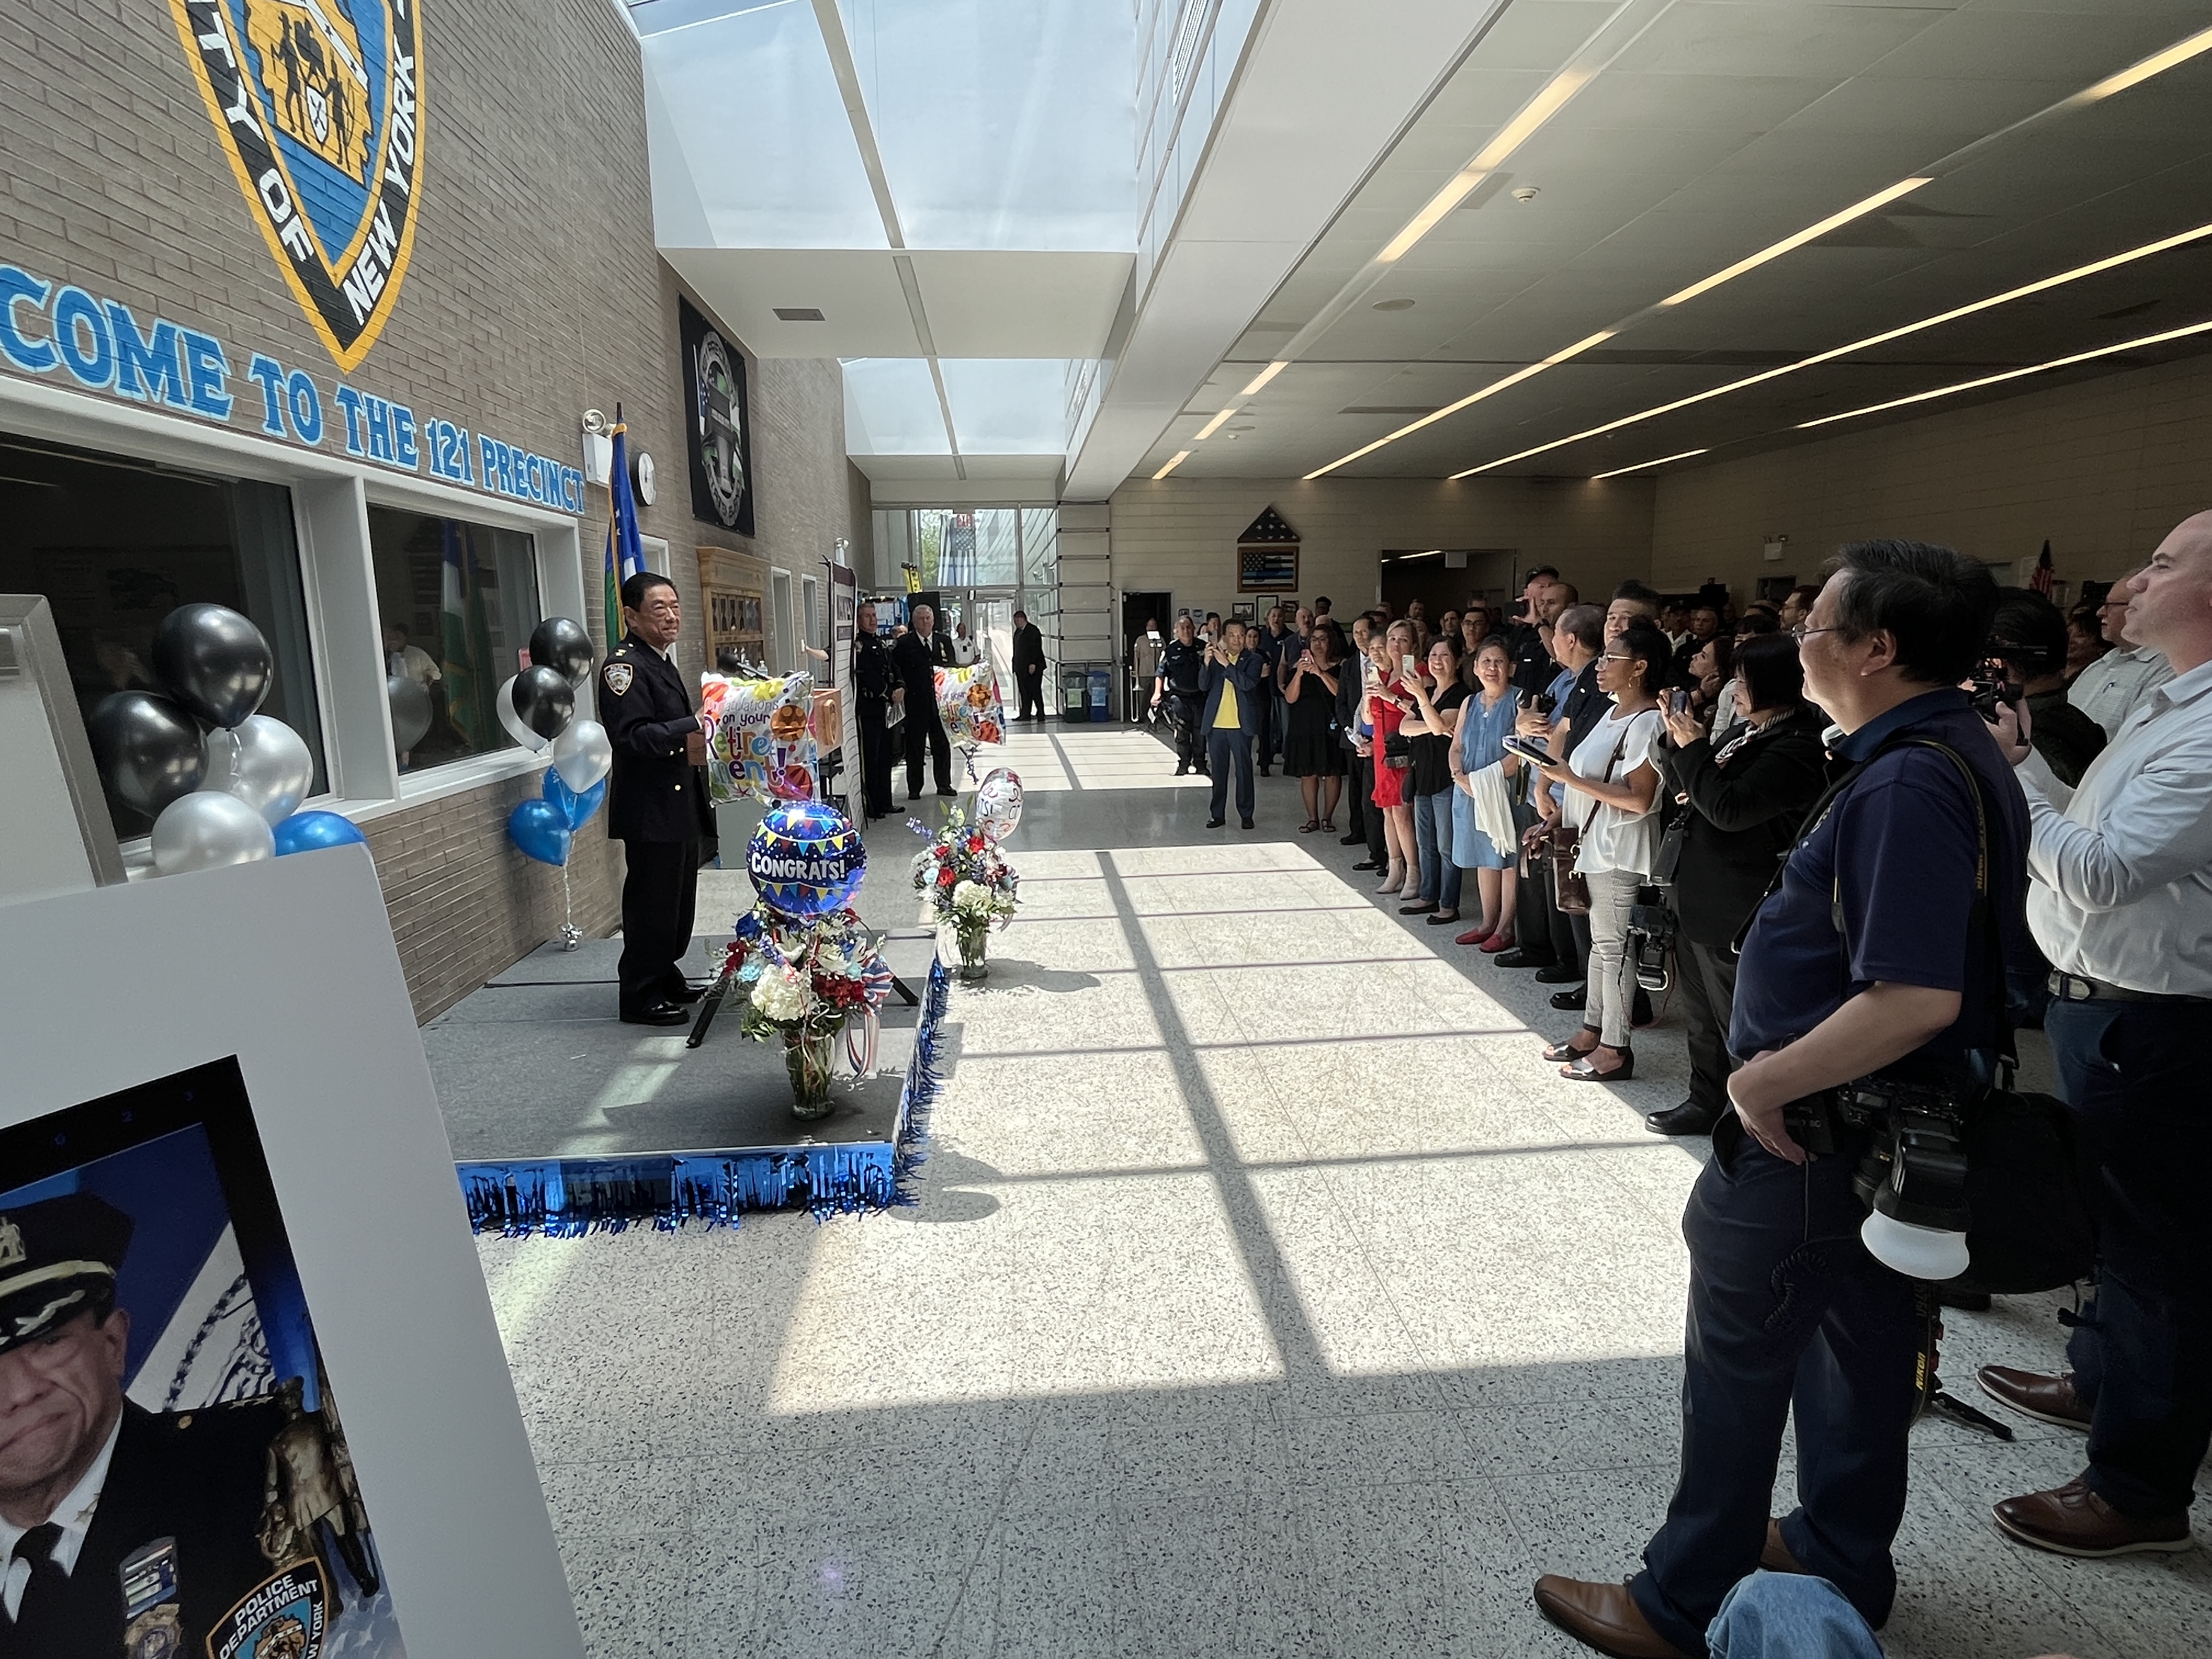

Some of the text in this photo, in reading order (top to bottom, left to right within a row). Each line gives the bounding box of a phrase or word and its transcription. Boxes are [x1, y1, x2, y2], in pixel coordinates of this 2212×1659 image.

[188, 0, 314, 263] TY OF
[342, 33, 415, 326] NEW YORK
[249, 351, 324, 446] TO
[335, 382, 419, 472] THE
[425, 417, 475, 487] 121
[478, 431, 586, 515] PRECINCT
[722, 713, 771, 727] on your
[709, 747, 787, 787] ment!
[751, 852, 845, 881] CONGRATS!
[219, 1579, 318, 1659] DEPARTMENT
[234, 1574, 295, 1626] POLICE
[311, 1600, 324, 1641] YORK
